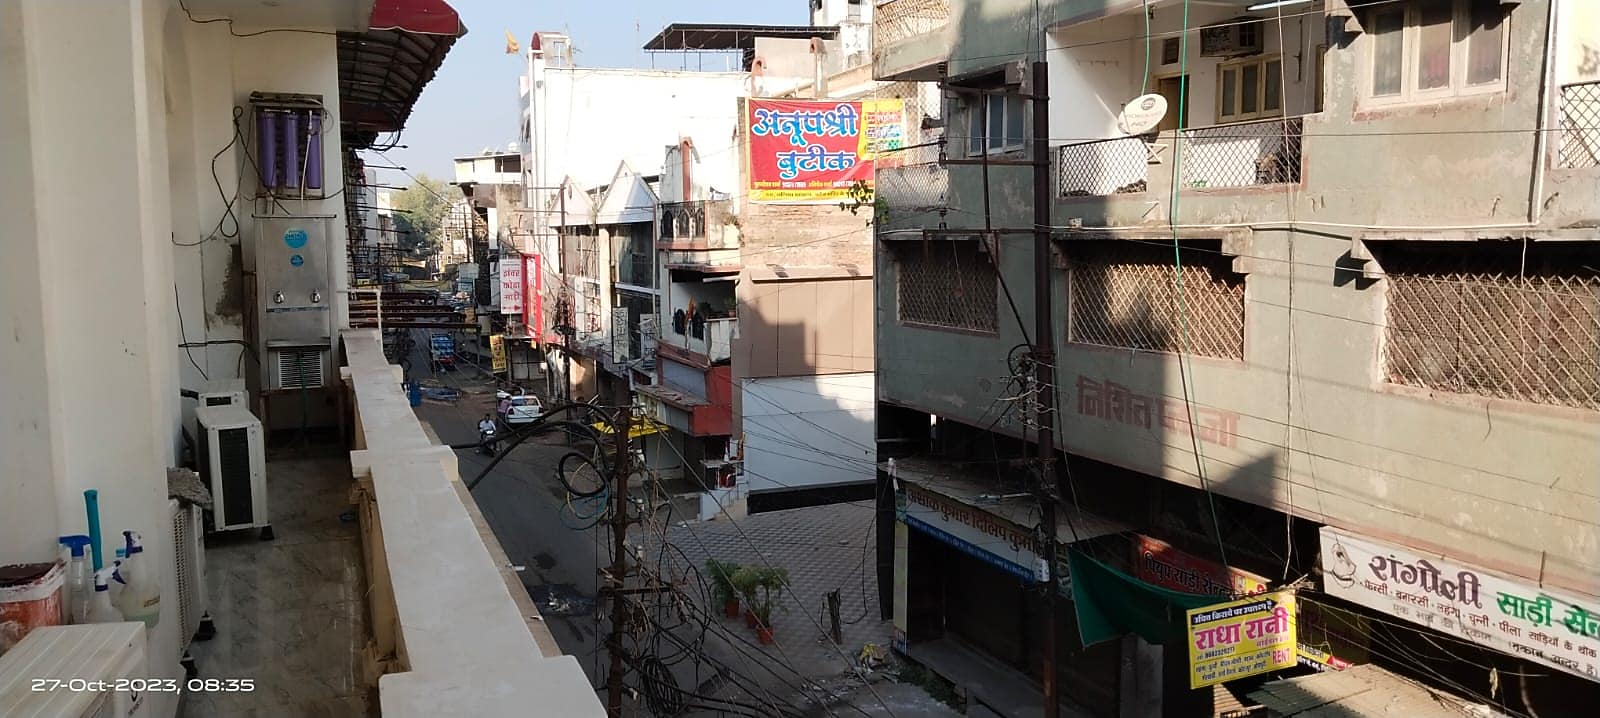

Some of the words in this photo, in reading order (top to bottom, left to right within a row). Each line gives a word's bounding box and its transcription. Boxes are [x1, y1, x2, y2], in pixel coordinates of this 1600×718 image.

[752, 103, 858, 146] अनूपश्री
[776, 144, 857, 179] बुटीक
[1194, 623, 1242, 650] राधा
[1245, 606, 1289, 639] रानी
[1272, 648, 1290, 664] RENT
